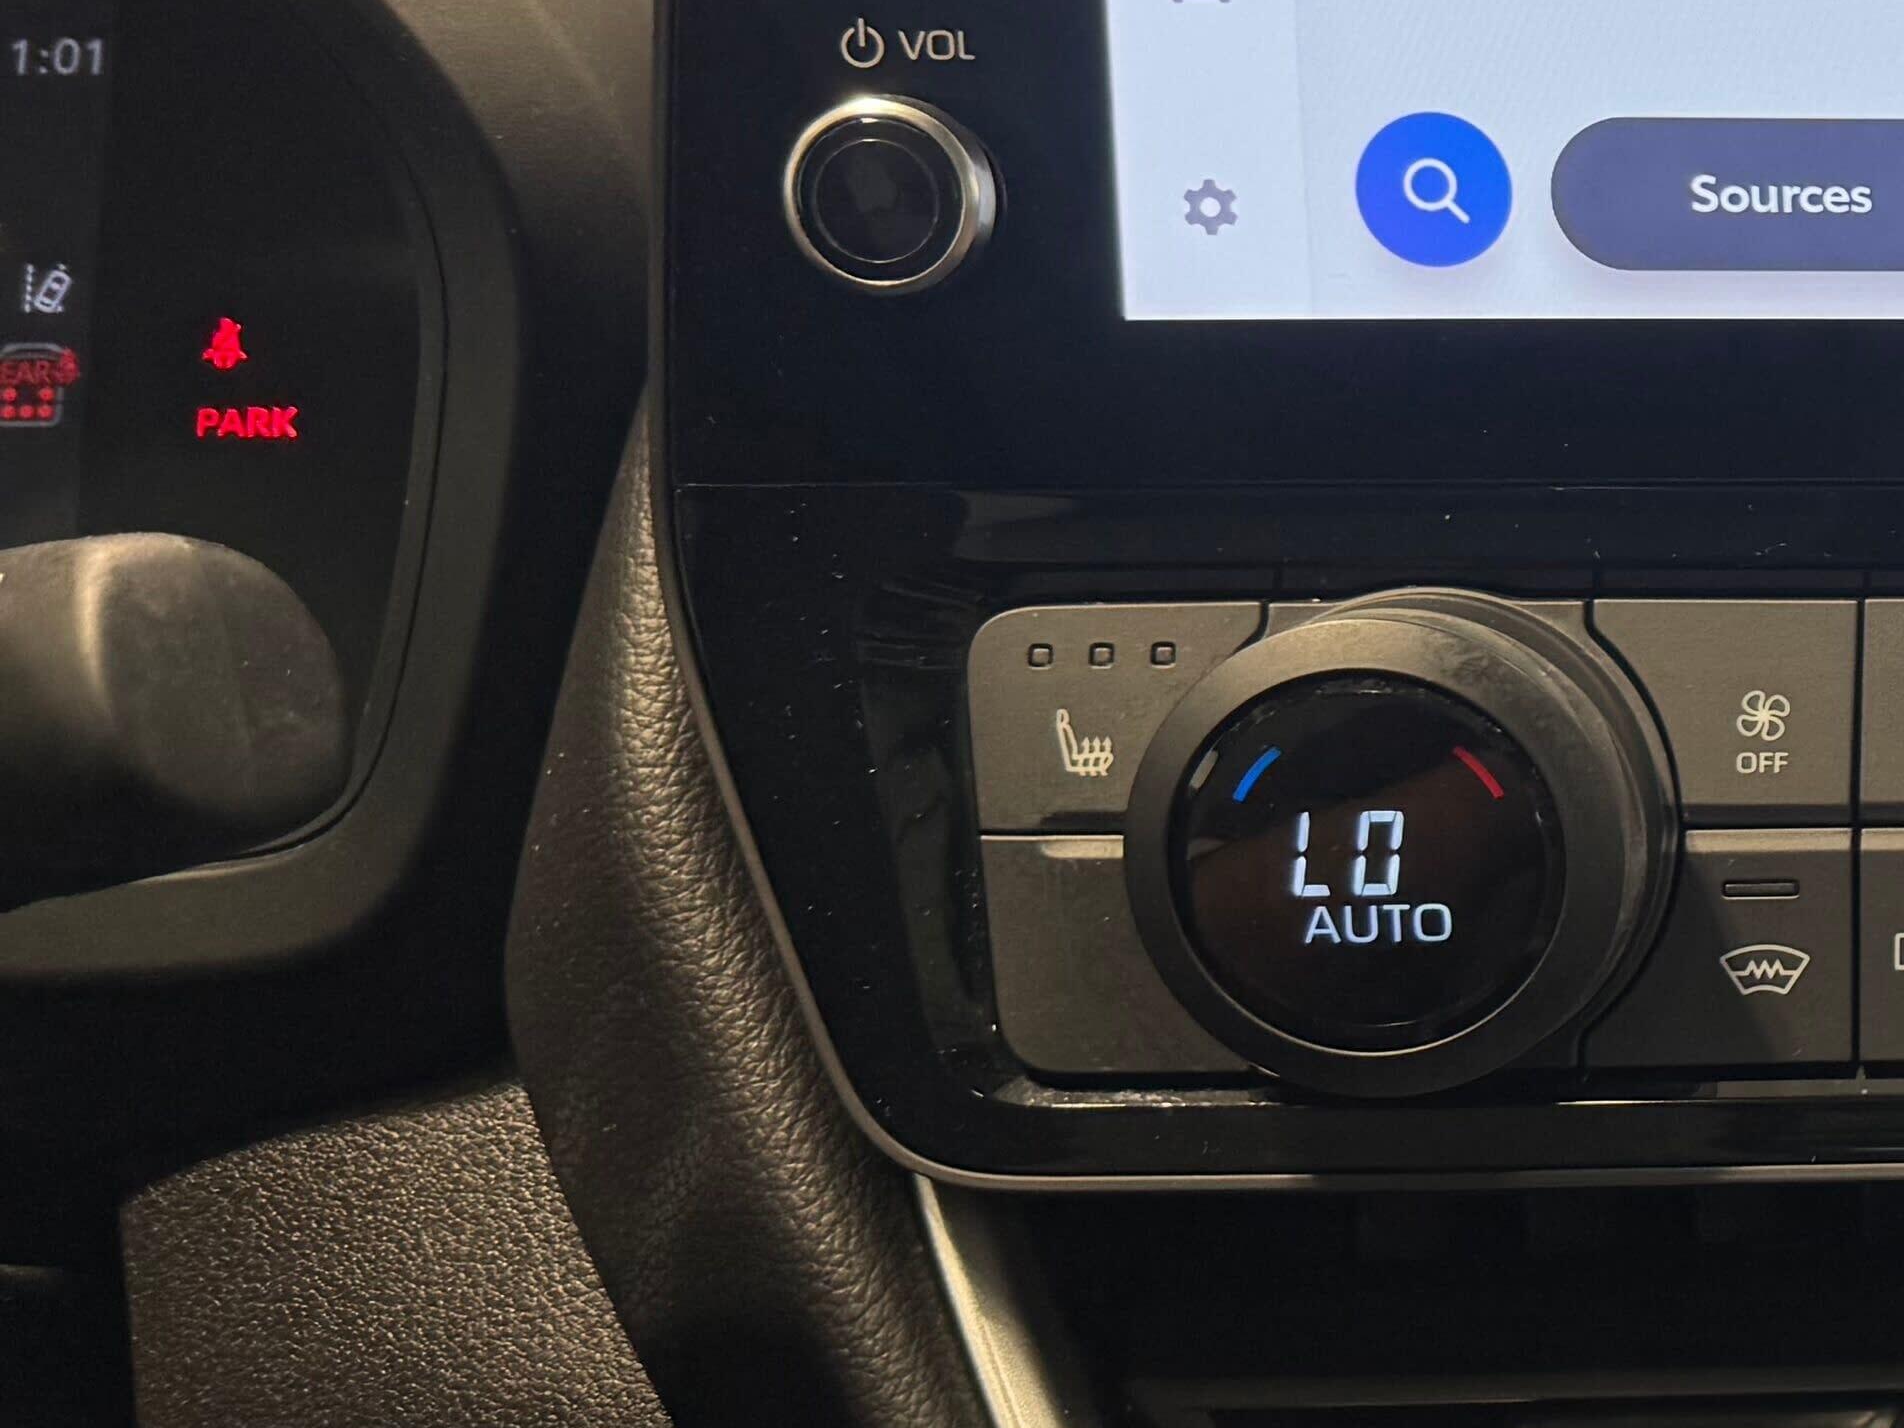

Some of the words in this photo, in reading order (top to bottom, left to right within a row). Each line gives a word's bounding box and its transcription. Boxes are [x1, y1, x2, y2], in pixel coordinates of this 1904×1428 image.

[11, 37, 104, 75] 1:01
[897, 29, 976, 62] VOL
[1689, 173, 1874, 215] Sources
[196, 406, 299, 439] PARK
[1735, 750, 1789, 774] OFF
[1304, 902, 1453, 945] AUTO
